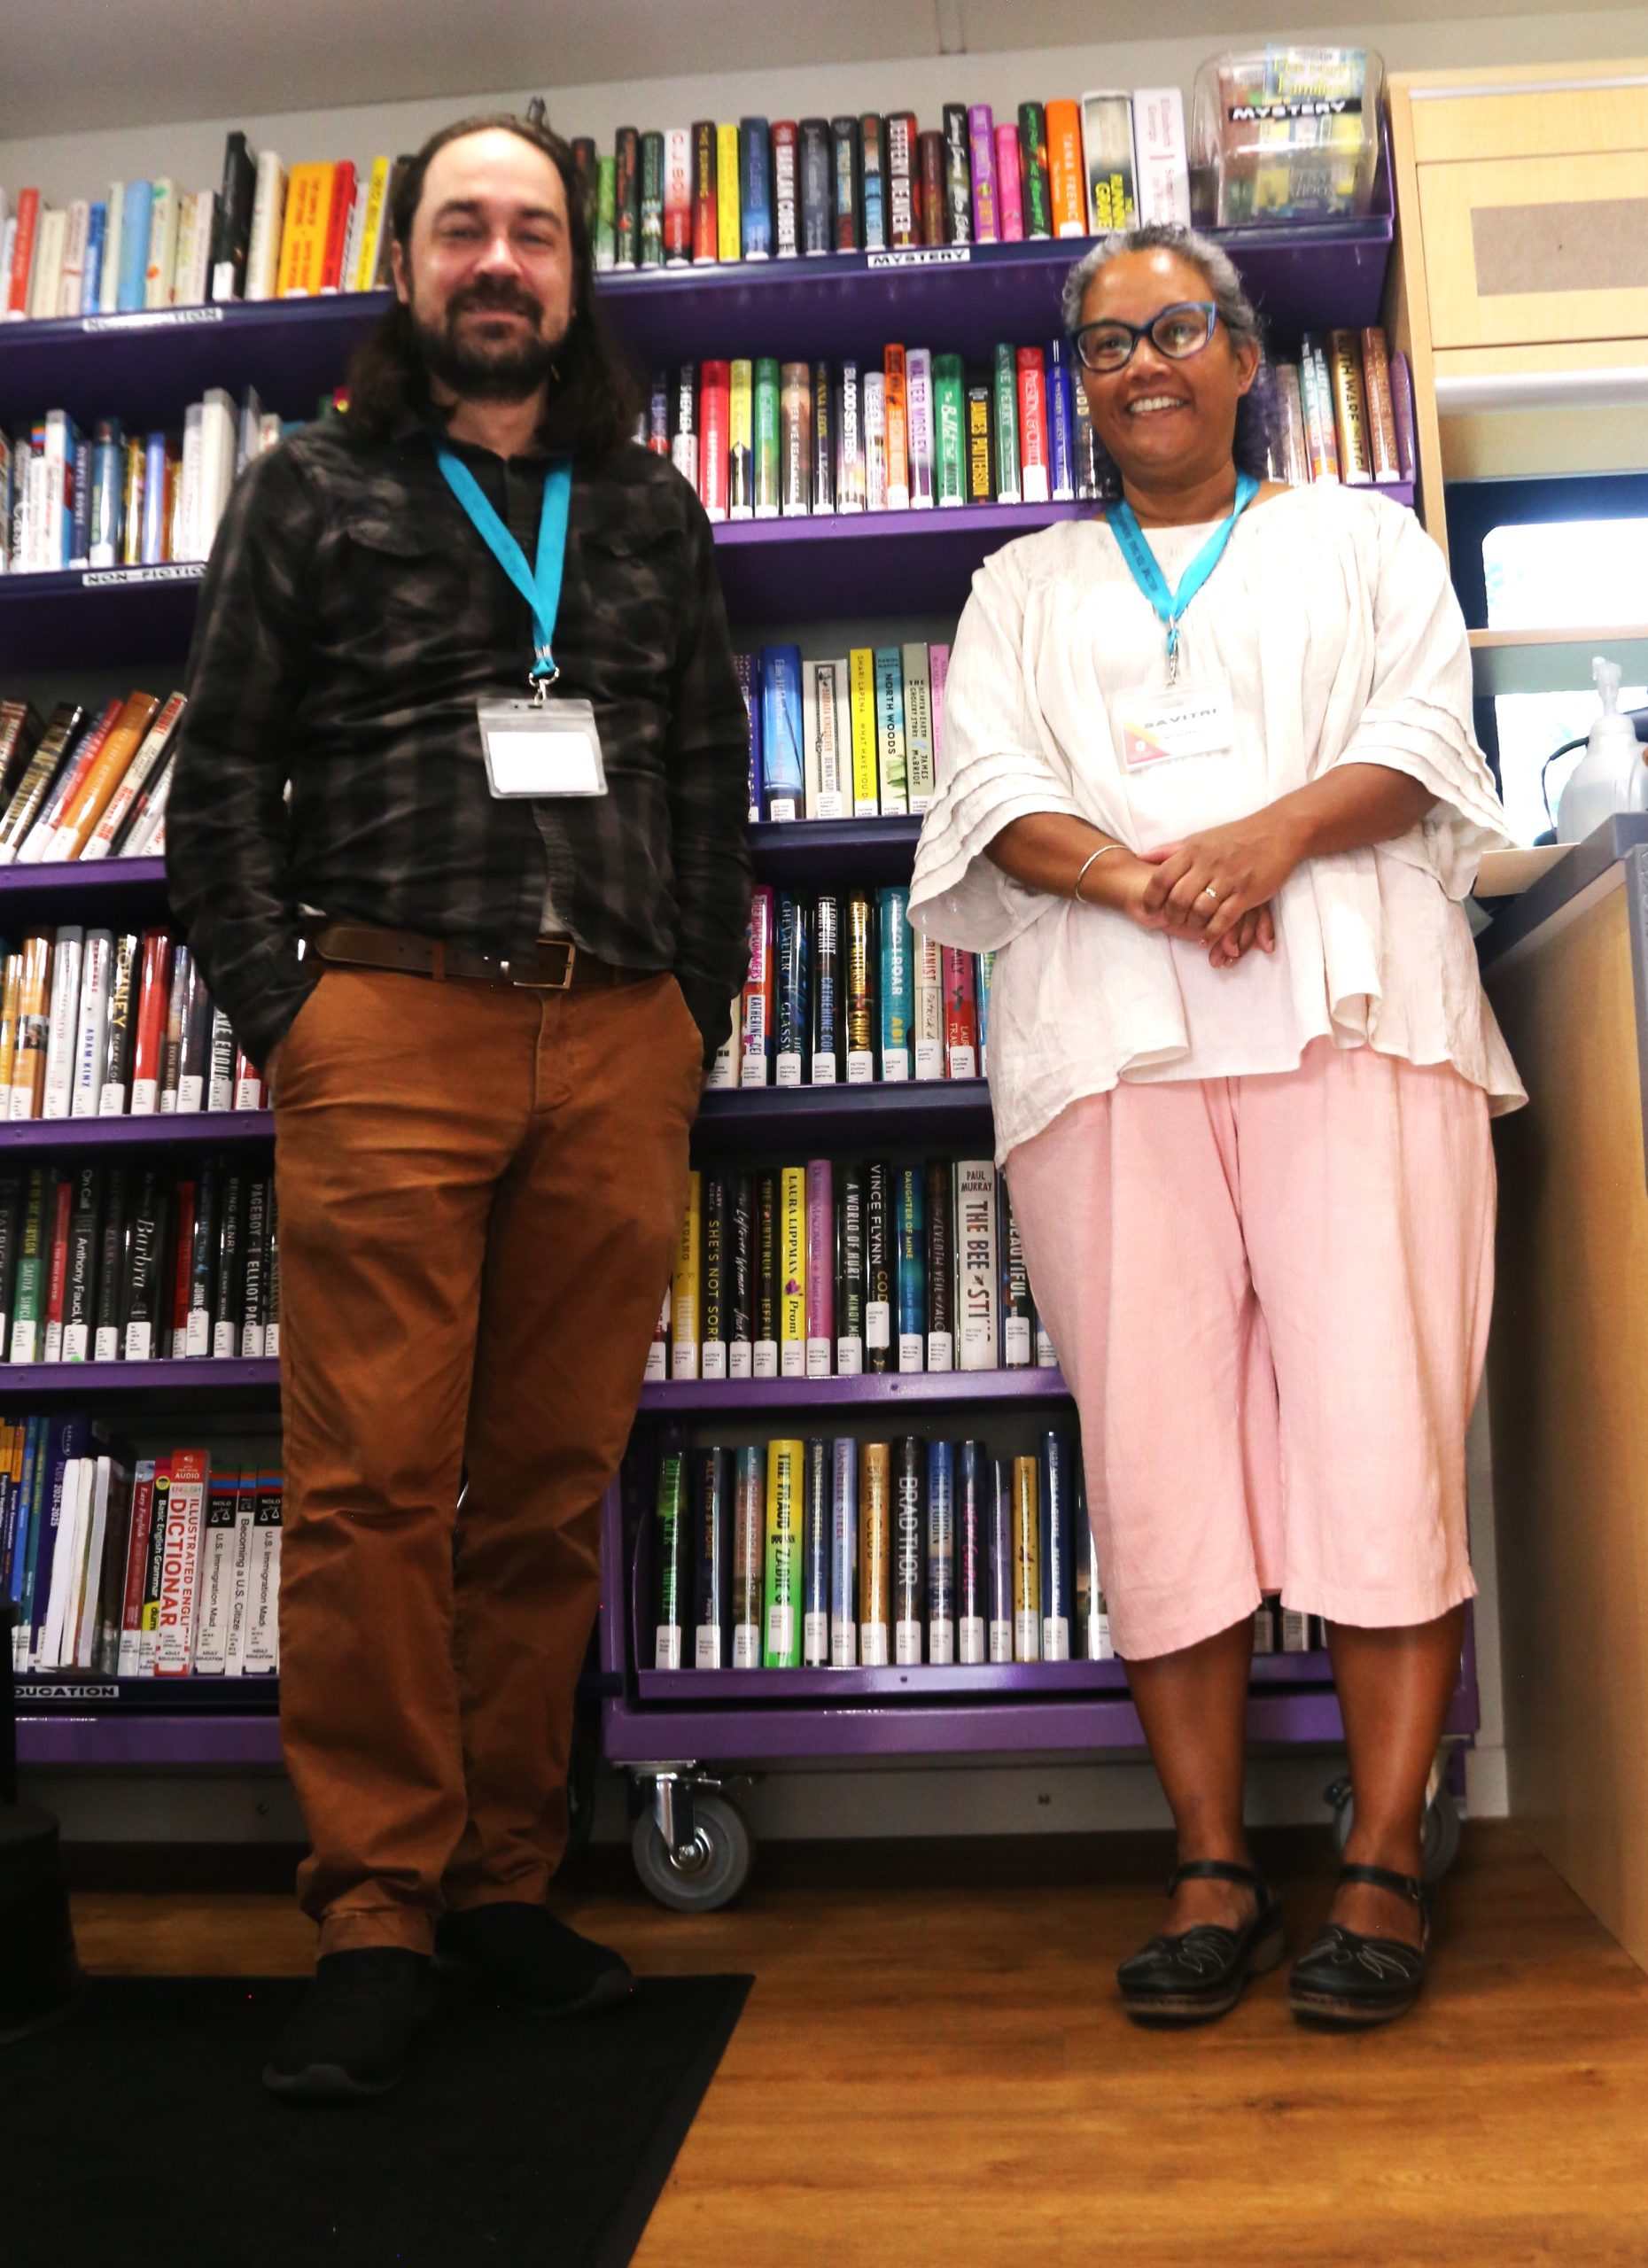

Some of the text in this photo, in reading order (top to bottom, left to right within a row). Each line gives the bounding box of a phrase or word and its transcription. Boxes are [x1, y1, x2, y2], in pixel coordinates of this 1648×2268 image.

[1232, 101, 1346, 120] MYSTERY
[1063, 133, 1074, 170] TANA
[874, 251, 964, 264] MYSTERY
[1000, 347, 1014, 426] ANNE PERRY
[1338, 337, 1358, 421] RUTH WARE
[843, 368, 856, 463] BLOOD SISTERS
[910, 358, 927, 454] WALTER MOSLEY
[1024, 369, 1039, 431] PRESTON &
[941, 404, 957, 440] Bullet
[970, 401, 989, 496] JAMES PATTERSON
[87, 563, 206, 582] NON-FICTIO
[774, 659, 787, 734] Elin Hilderbrand
[884, 673, 895, 711] NORTH
[822, 688, 833, 777] BARBARA KINGSOLVER DEMON
[1145, 709, 1217, 728] SAVITRI
[781, 900, 791, 971] CHEVALIER
[112, 938, 129, 1028] ROMNEY
[819, 897, 836, 1032] FLASHPOINT CATHERINE
[750, 997, 763, 1038] KATHERINE
[891, 955, 903, 1044] ROAR ABI
[925, 993, 936, 1027] Patrick
[84, 1029, 94, 1057] ADAM
[214, 1040, 231, 1081] ENOUG
[229, 1178, 238, 1212] BEING
[762, 1180, 771, 1200] THE
[789, 1175, 797, 1215] LAURA
[961, 1182, 992, 1192] MURRAY
[967, 1171, 986, 1180] PAUL
[812, 1204, 821, 1261] MACOMBER
[847, 1194, 859, 1231] WORLD
[871, 1165, 881, 1264] VINCE FLYNN
[906, 1223, 913, 1234] OF
[71, 1169, 92, 1317] On Call Anthony Fauci,
[132, 1218, 154, 1287] Barbra
[226, 1216, 236, 1254] HENRY
[245, 1184, 263, 1301] PAGEBOY ELLIOT
[681, 1221, 690, 1261] KUANG
[735, 1208, 750, 1296] Leftover Woman
[848, 1236, 859, 1247] OF
[967, 1200, 990, 1270] THE BEE
[21, 1264, 35, 1291] SAFIYA
[708, 1221, 719, 1342] SHE'S NOT SORR
[762, 1252, 771, 1278] RULE
[848, 1253, 859, 1279] HURT
[934, 1271, 944, 1293] VEIL
[193, 1282, 205, 1302] JOHN
[812, 1276, 821, 1297] Must
[762, 1299, 771, 1323] JEFF
[789, 1301, 798, 1333] Prom
[848, 1294, 859, 1322] MINDY
[812, 1445, 823, 1542] DANIELLE STEEL
[836, 1443, 846, 1541] DANIELLE STEEL
[932, 1465, 950, 1500] COLM
[50, 1484, 63, 1527] 2024-2025
[136, 1508, 146, 1537] English
[775, 1453, 790, 1590] THE FRAUD ZADIE
[151, 1500, 166, 1597] Basic English Grammar
[183, 1498, 199, 1584] ILLUSTRATED
[236, 1518, 249, 1568] Becoming
[898, 1477, 917, 1585] BRAD THOR
[964, 1503, 976, 1593] NEW COUPLE
[159, 1498, 187, 1626] DICTIONAR
[210, 1554, 222, 1605] Immigration
[259, 1531, 273, 1604] U.S. Immigration
[236, 1580, 245, 1600] U.S.
[15, 1687, 115, 1697] DUCATION
